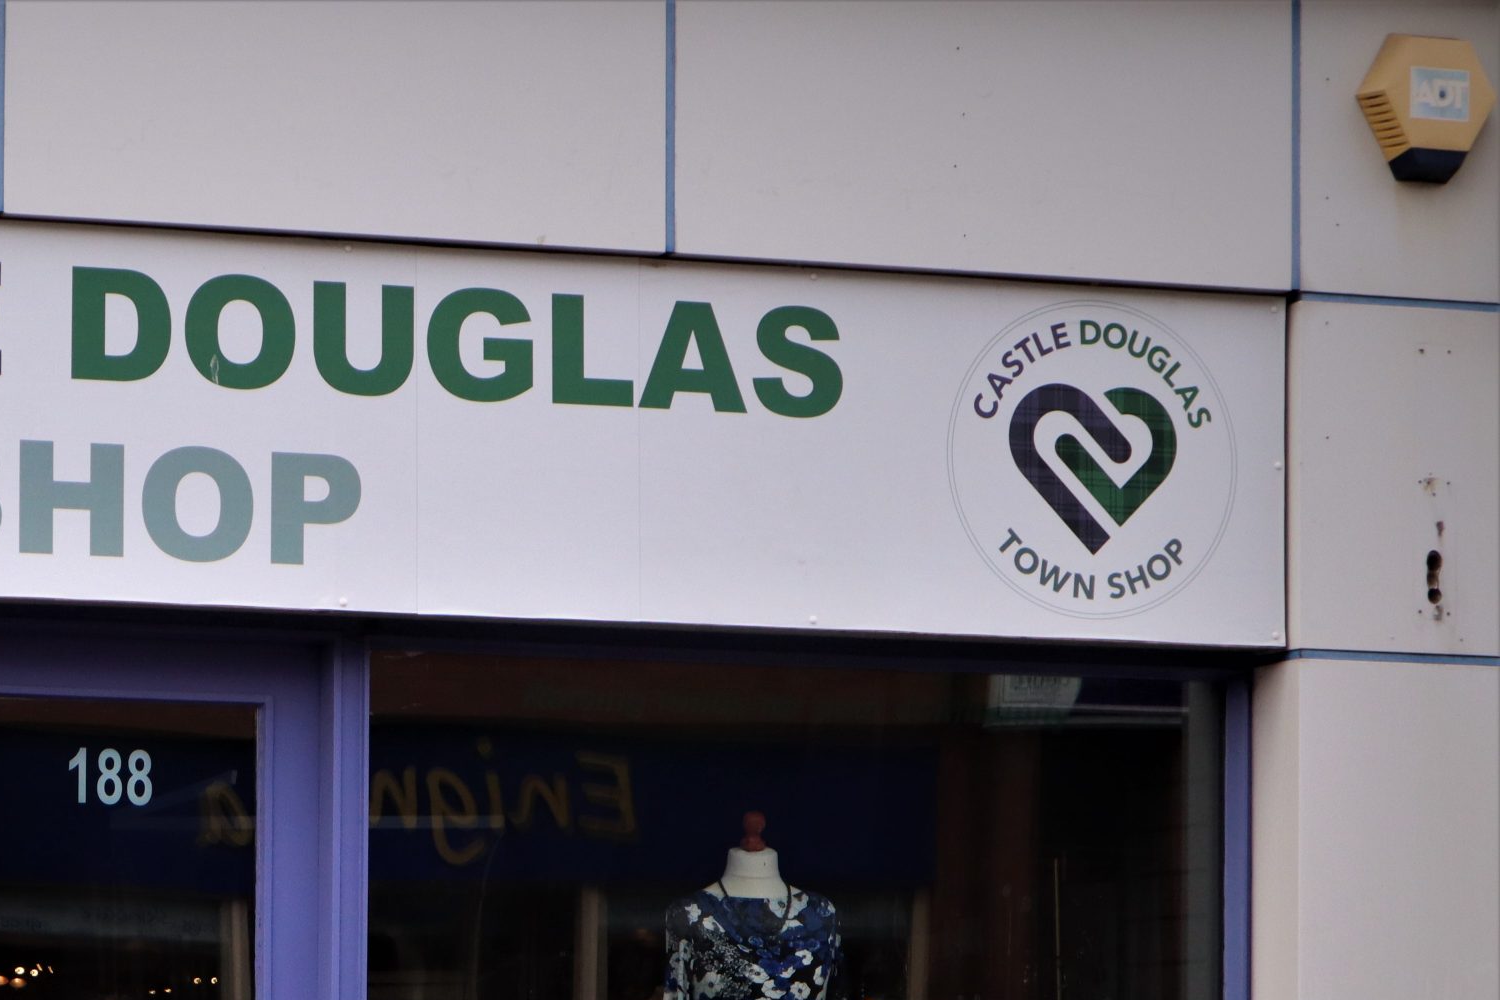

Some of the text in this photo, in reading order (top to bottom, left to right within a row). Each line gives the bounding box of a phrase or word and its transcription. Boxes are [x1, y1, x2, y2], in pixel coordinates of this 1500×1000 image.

[1410, 79, 1468, 110] ADT
[71, 265, 844, 418] DOUGLAS
[973, 319, 1212, 430] CASTLE DOUGLAS
[997, 528, 1186, 601] TOWN SHOP
[68, 747, 153, 807] 188
